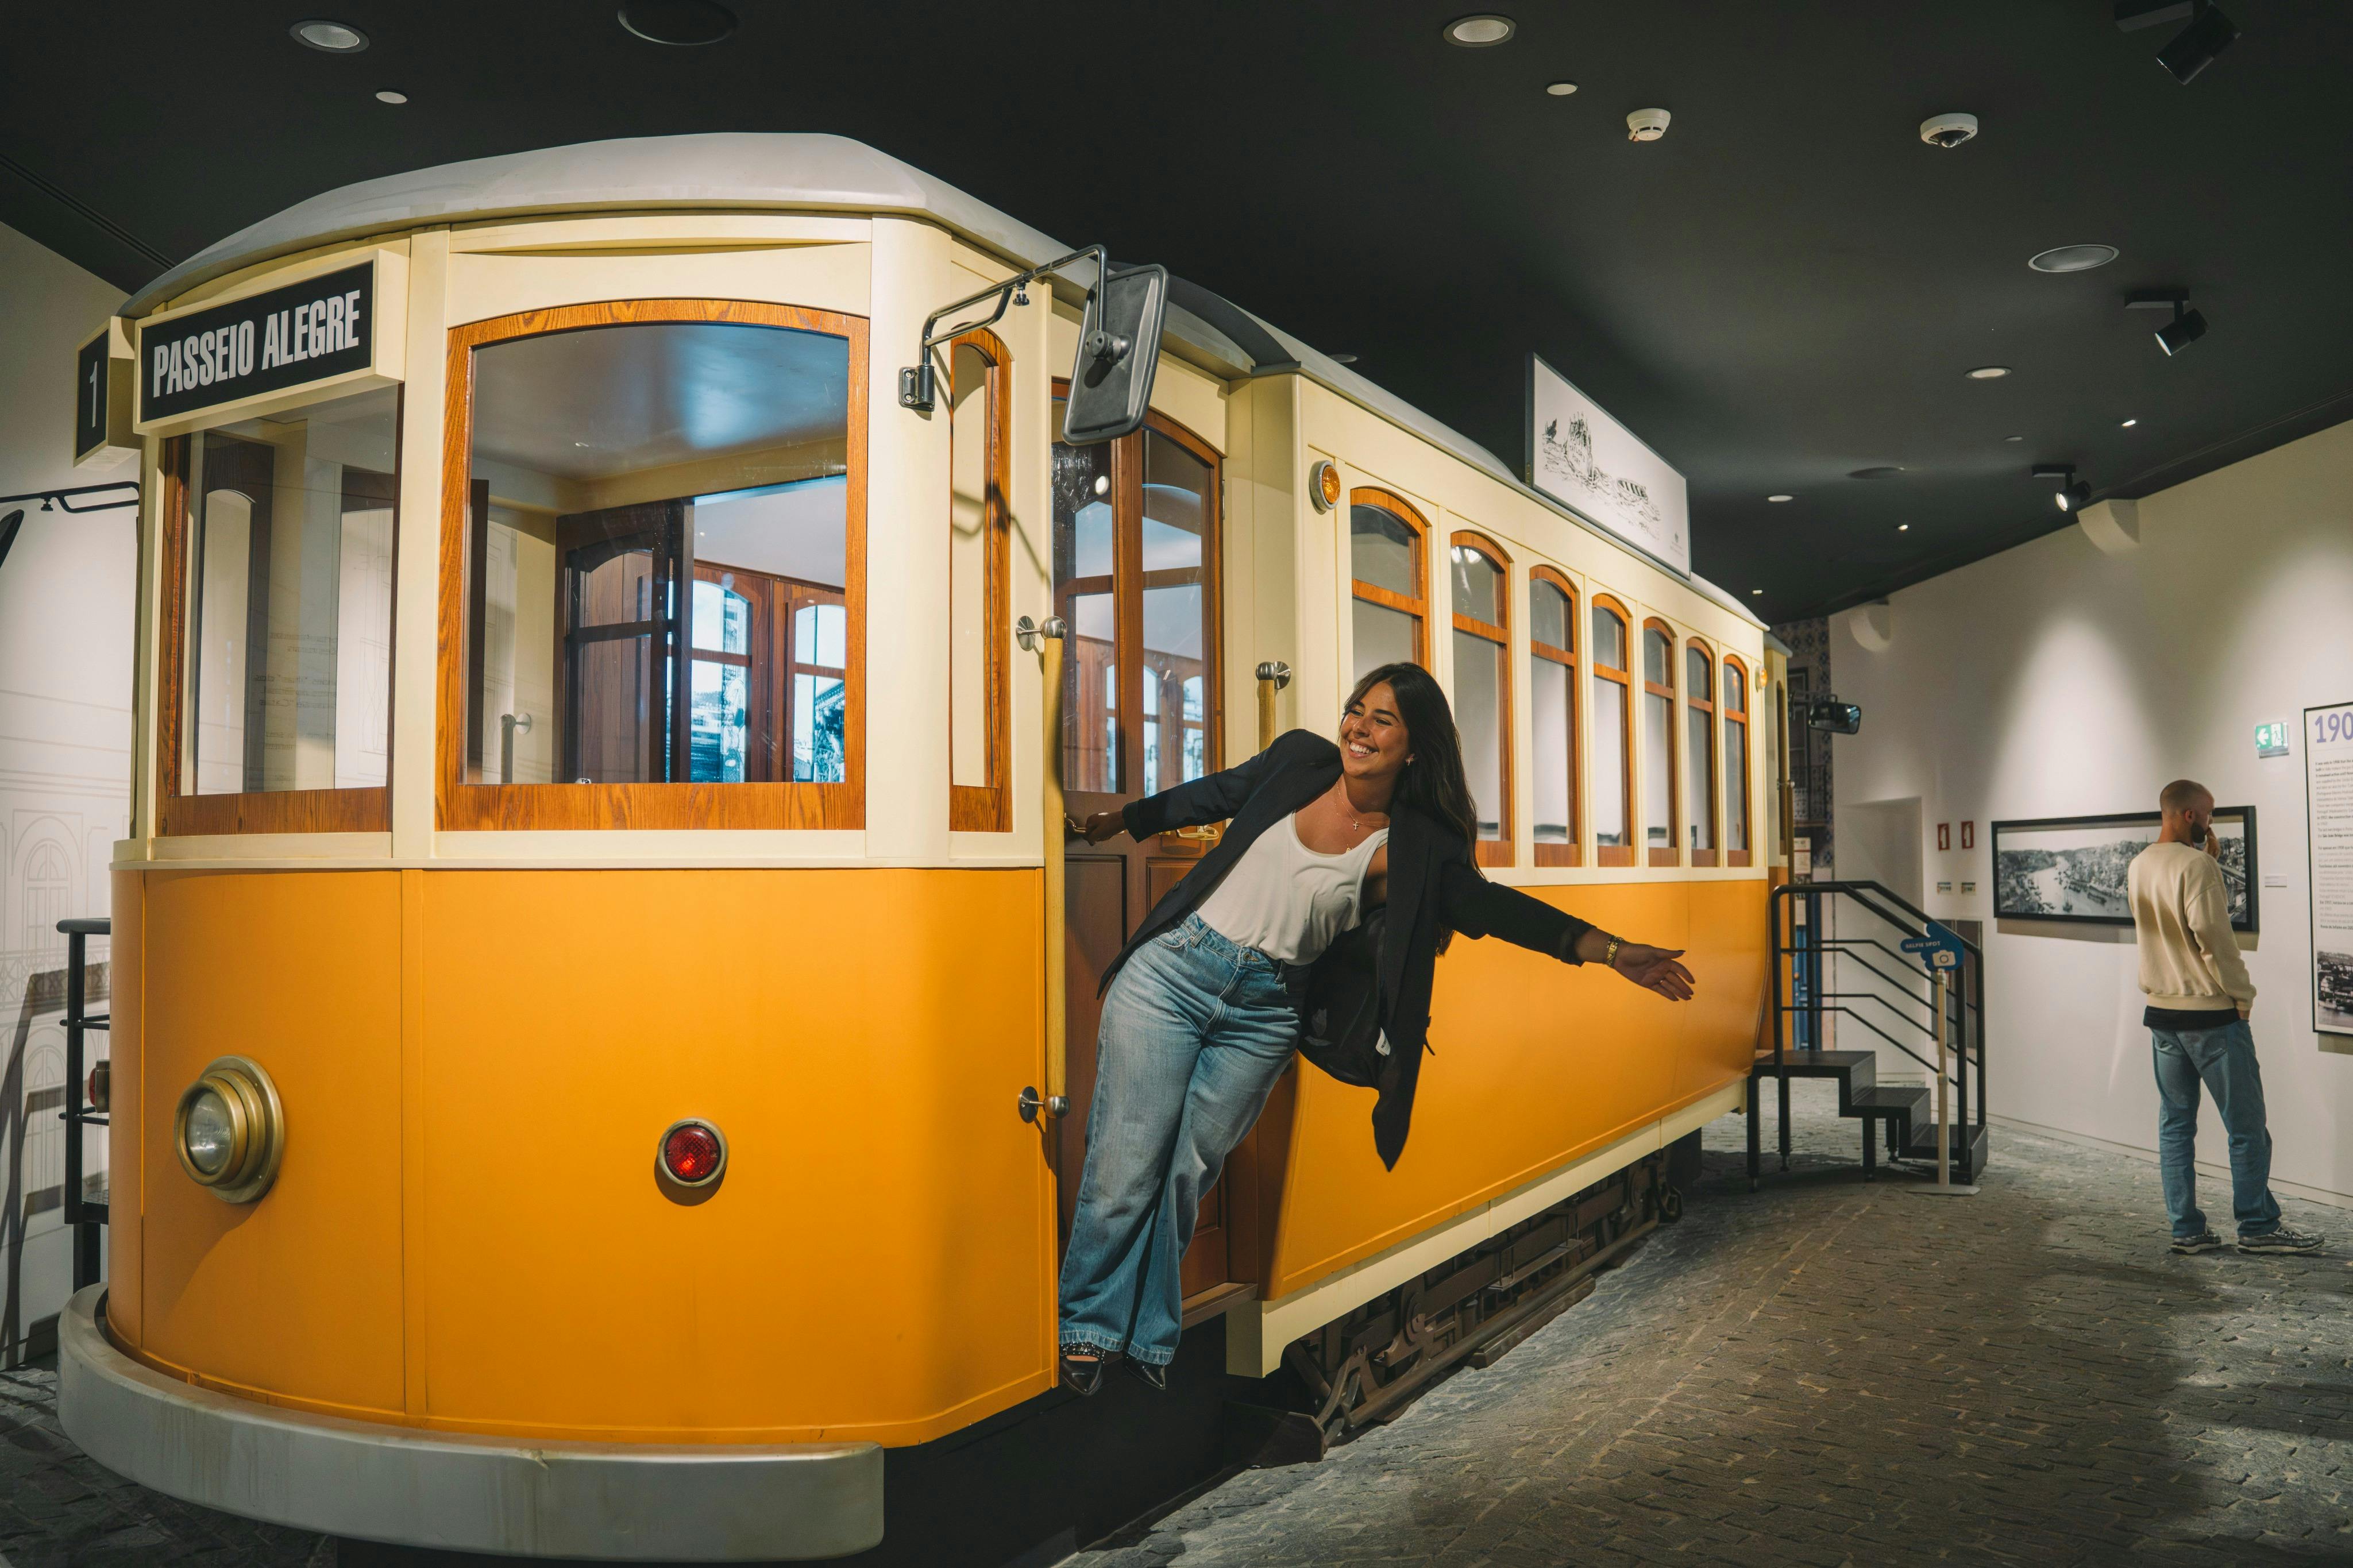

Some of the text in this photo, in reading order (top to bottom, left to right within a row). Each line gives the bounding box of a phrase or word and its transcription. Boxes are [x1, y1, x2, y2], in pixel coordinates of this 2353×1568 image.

[152, 289, 361, 399] PASSEIO ALEGRE
[89, 360, 99, 428] 1
[2315, 712, 2353, 743] 190
